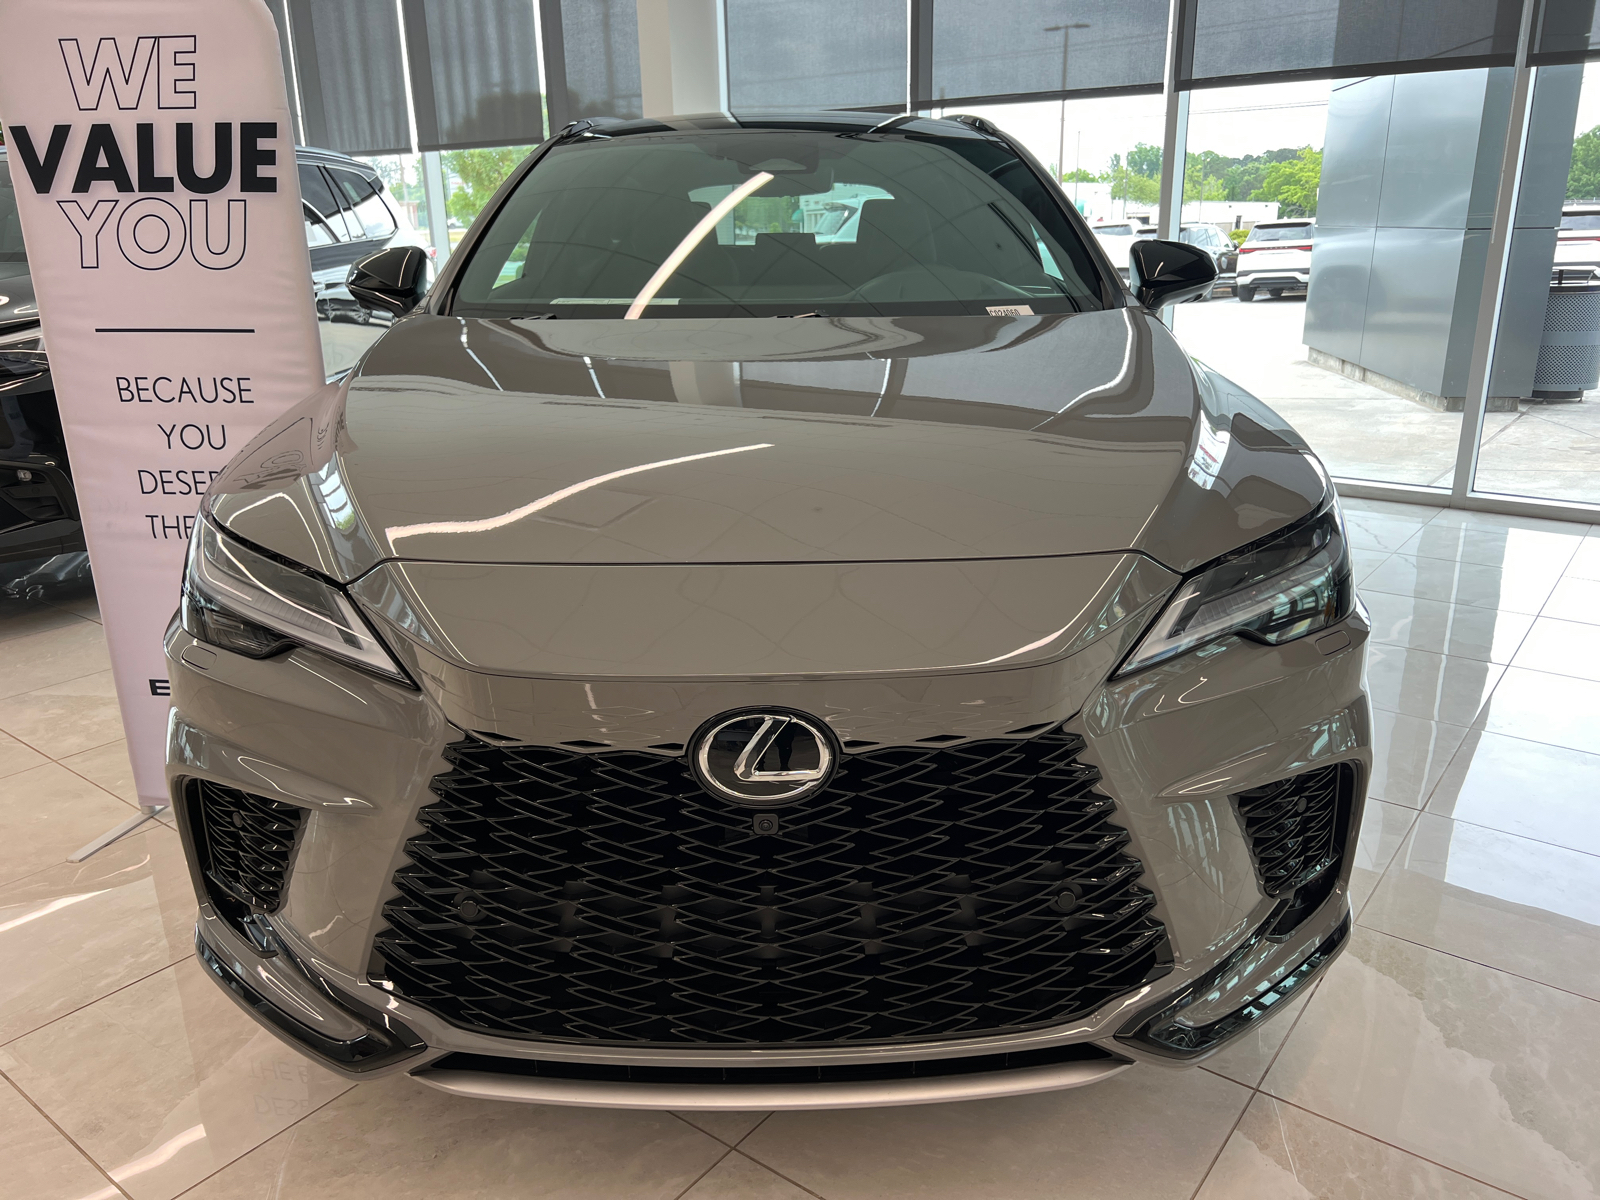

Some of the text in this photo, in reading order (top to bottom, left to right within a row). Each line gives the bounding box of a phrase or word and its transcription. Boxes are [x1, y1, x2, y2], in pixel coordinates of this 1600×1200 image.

[58, 35, 197, 111] WE
[8, 122, 278, 194] VALUE
[56, 197, 246, 270] YOU
[115, 376, 255, 404] BECAUSE
[157, 423, 227, 450] YOU
